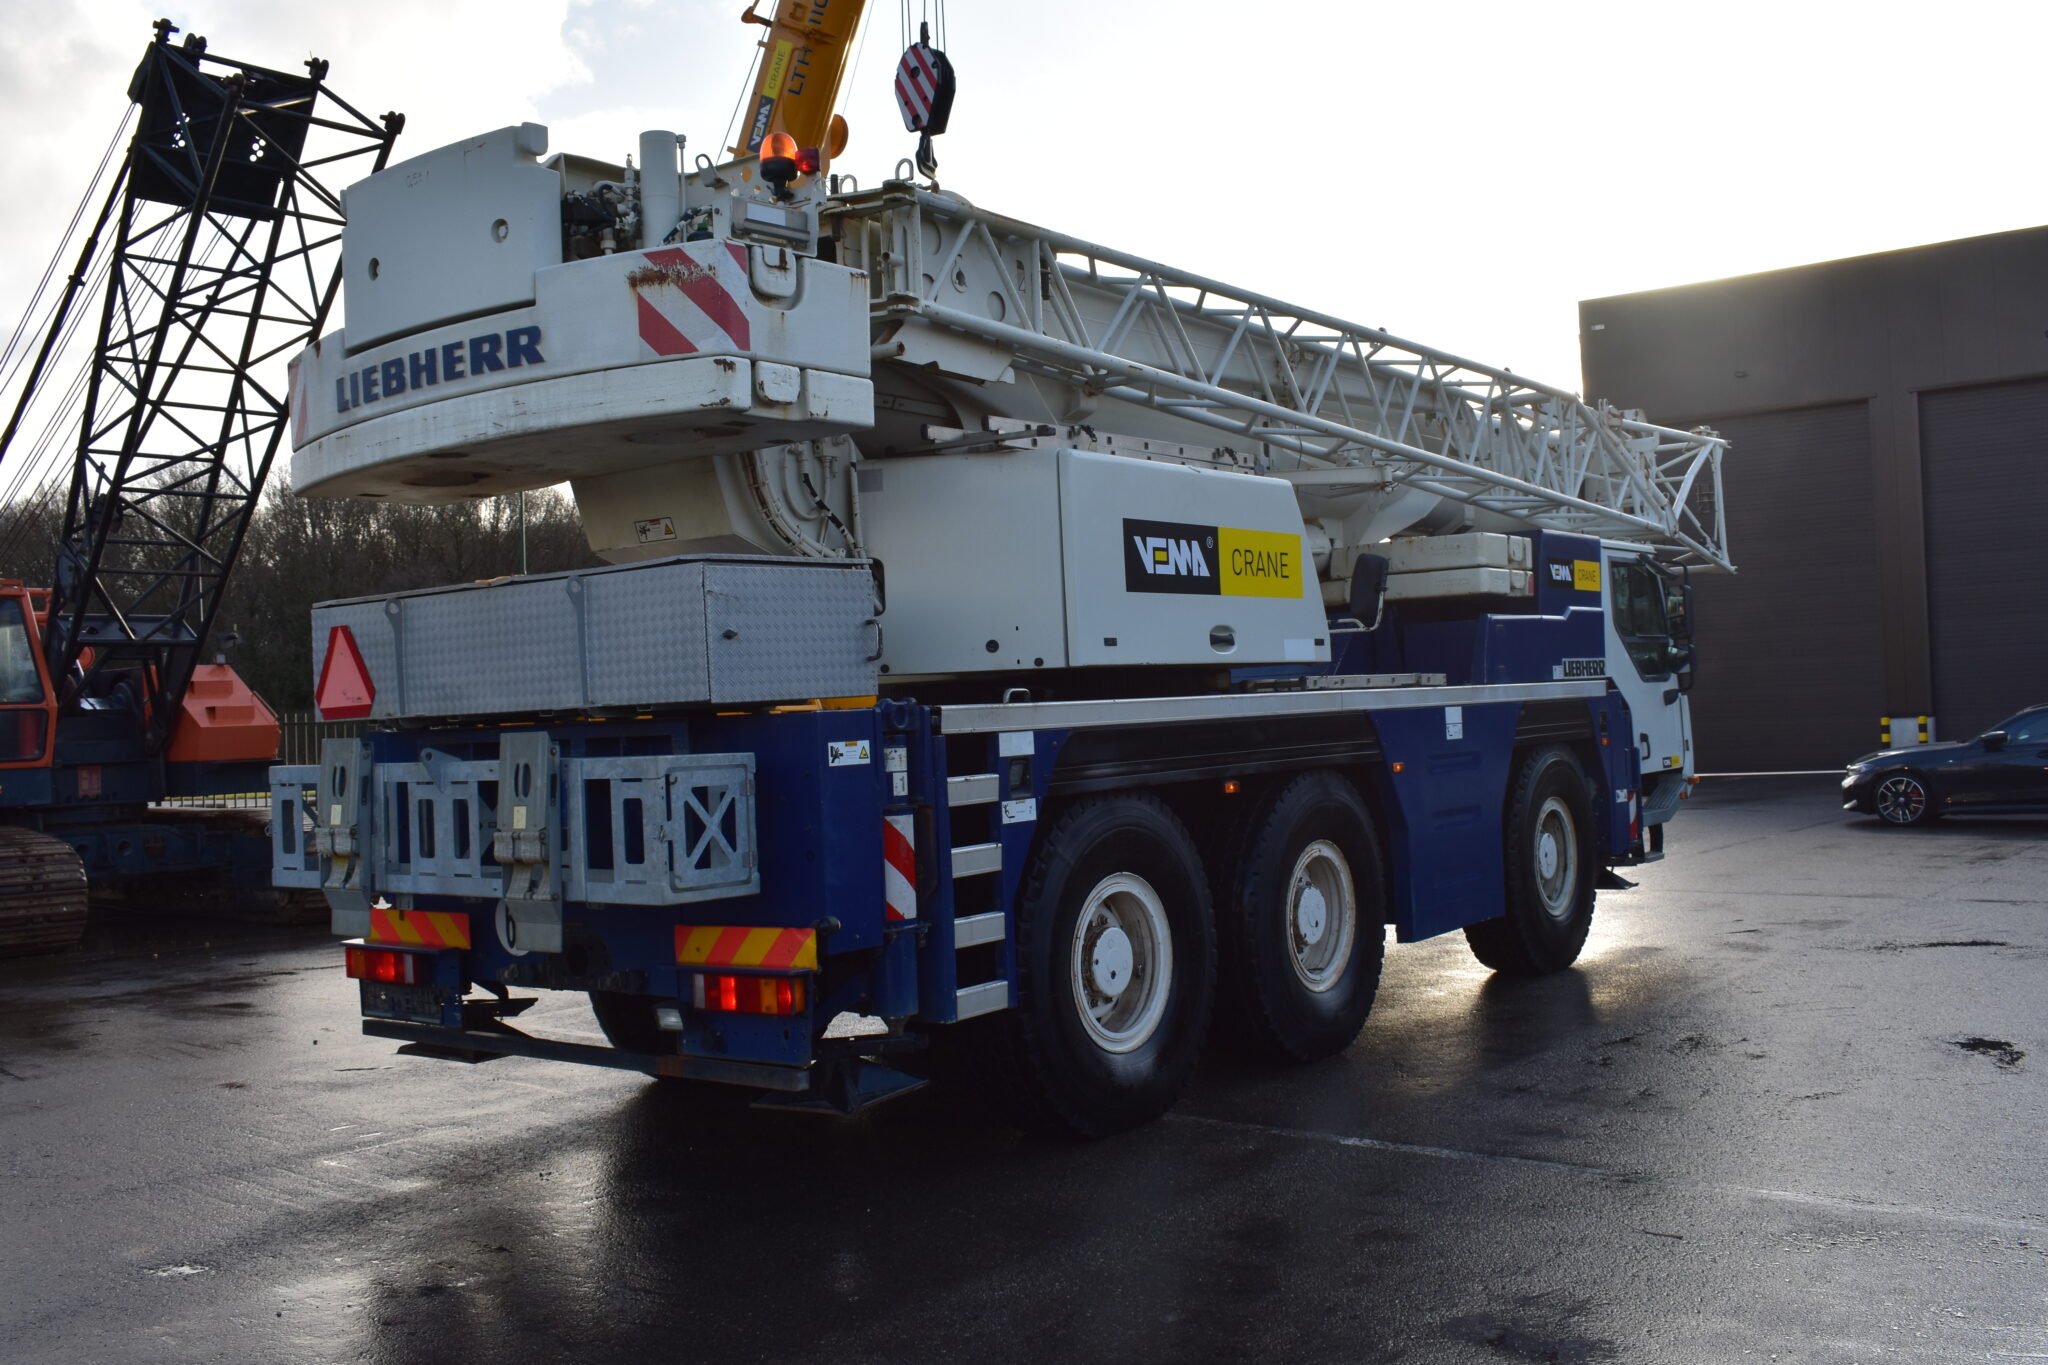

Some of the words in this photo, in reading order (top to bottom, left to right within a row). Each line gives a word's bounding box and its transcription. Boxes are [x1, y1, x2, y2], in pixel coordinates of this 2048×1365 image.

[750, 103, 771, 146] VEMA
[768, 49, 786, 90] CRANE
[335, 325, 545, 413] LIEBHERR
[1133, 535, 1211, 577] VEMA
[1231, 548, 1290, 578] CRANE
[1549, 563, 1572, 581] VEMA
[1577, 568, 1596, 583] CRANE
[1563, 660, 1606, 677] LIEBHERR
